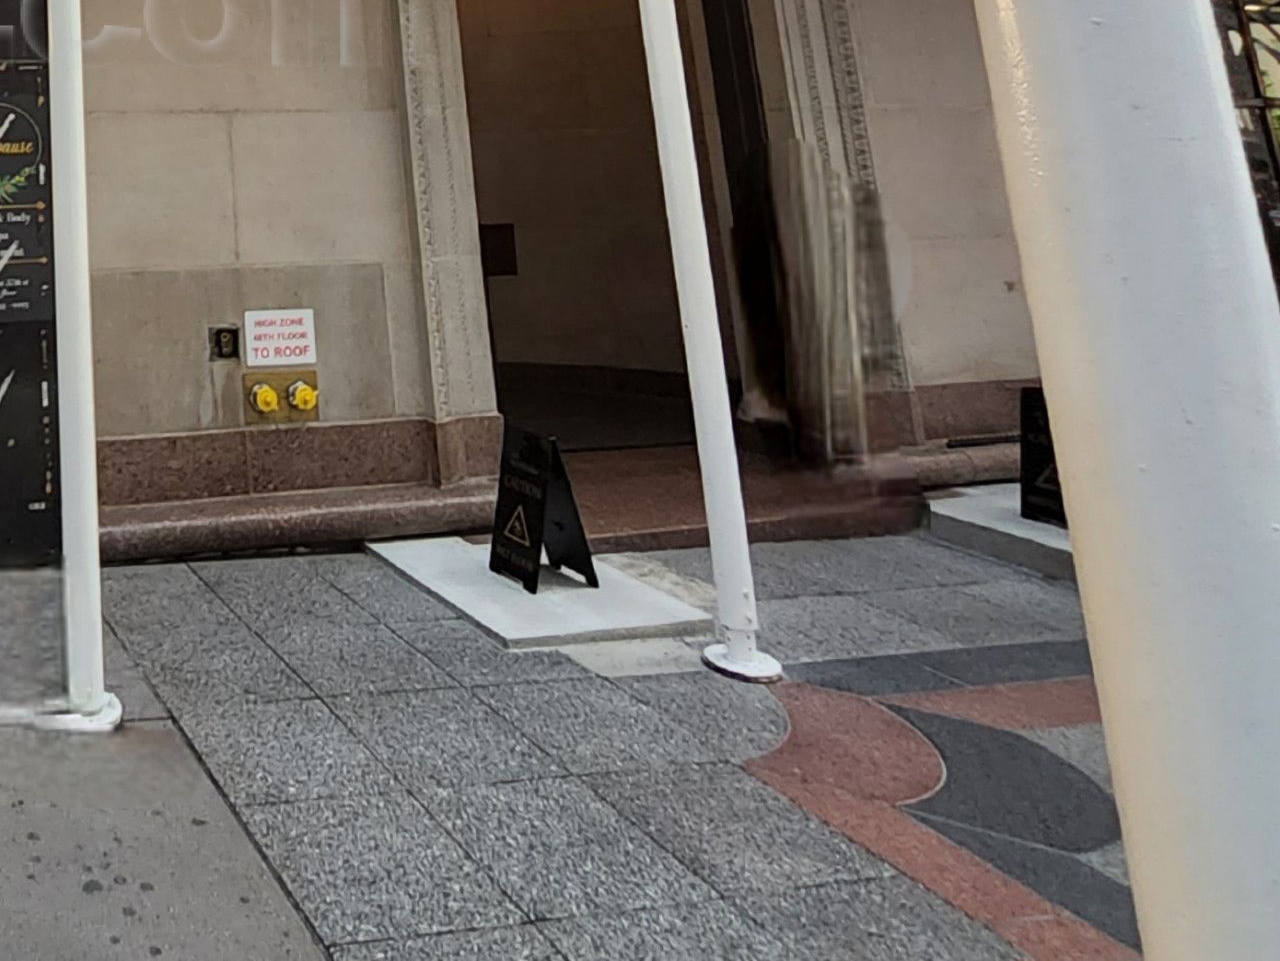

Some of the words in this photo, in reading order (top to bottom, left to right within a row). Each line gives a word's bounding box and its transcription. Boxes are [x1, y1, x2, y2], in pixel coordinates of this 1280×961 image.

[6, 212, 31, 225] Body
[254, 318, 277, 328] HIGH
[279, 317, 304, 327] ZONE
[277, 331, 308, 340] FLOOR
[253, 347, 270, 358] TO
[274, 345, 310, 357] ROOF
